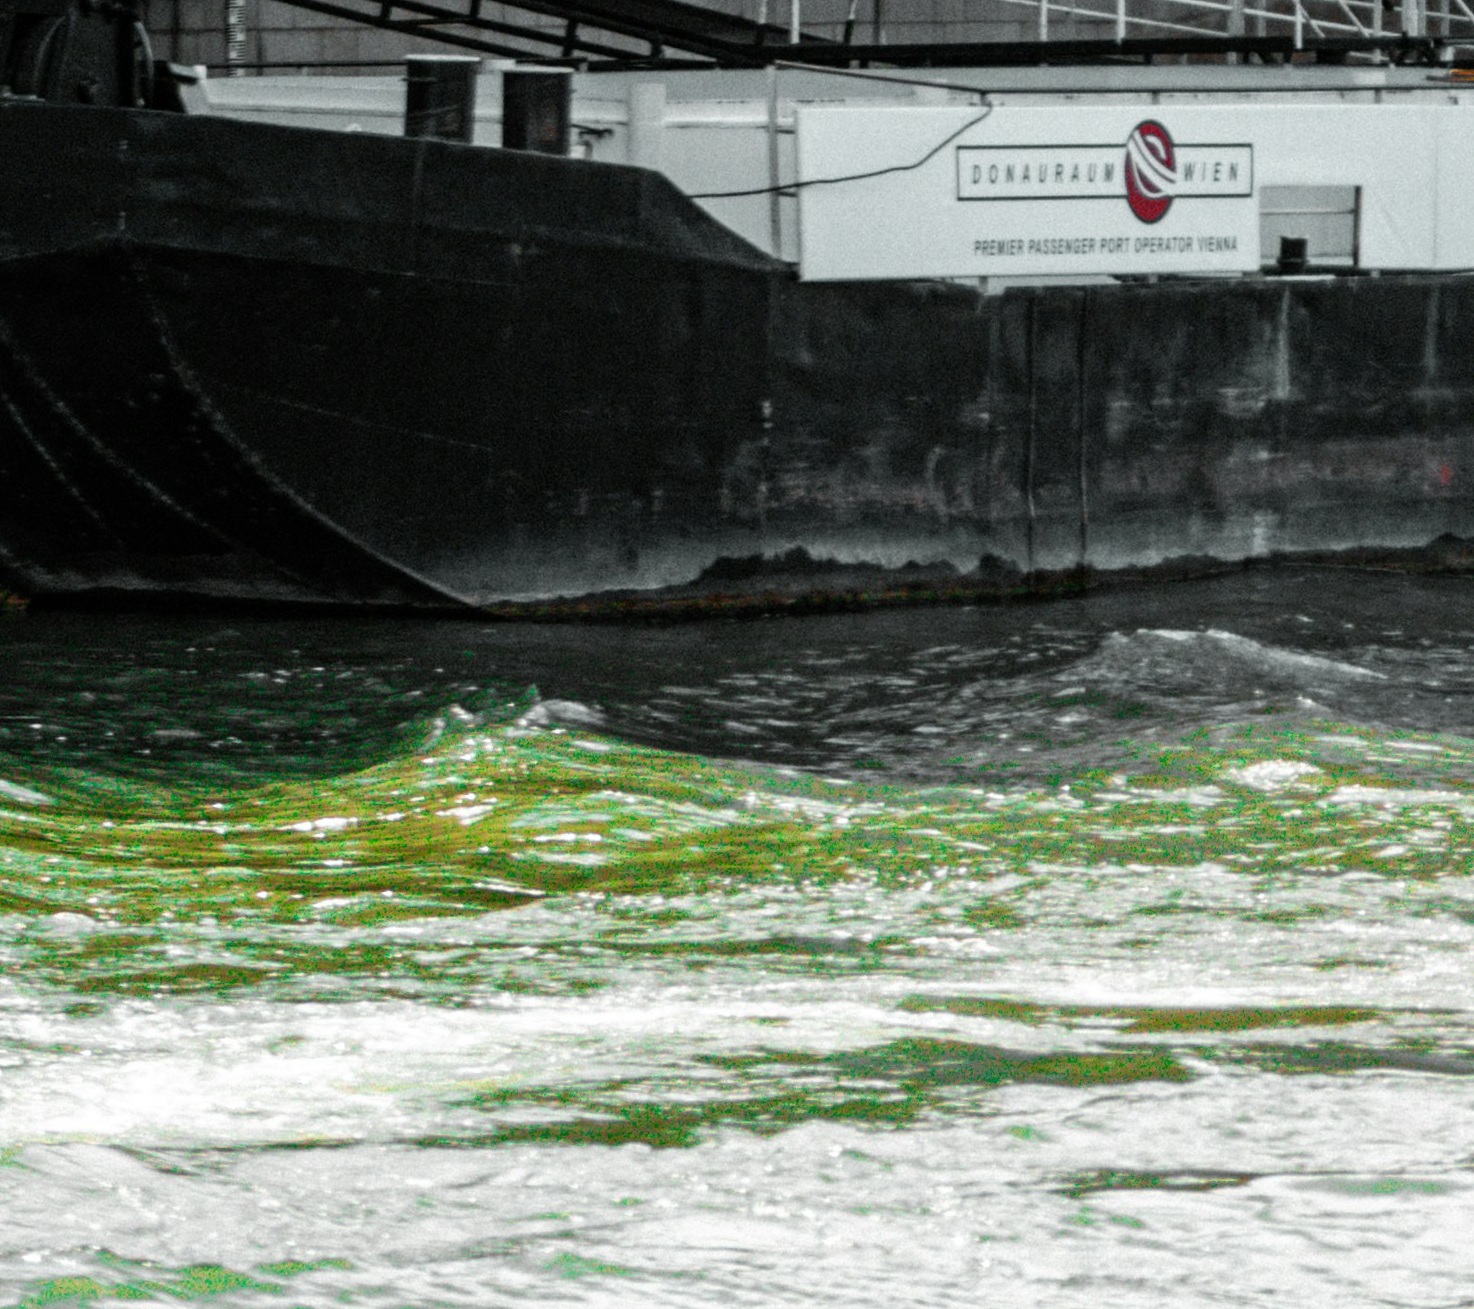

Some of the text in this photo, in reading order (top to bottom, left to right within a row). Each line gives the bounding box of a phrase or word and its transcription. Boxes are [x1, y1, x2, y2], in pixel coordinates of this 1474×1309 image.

[971, 162, 1239, 184] DONAURAUM WIEN
[974, 236, 1239, 256] PREMIER PASSENGER PORT OPERATOR VIENNA
